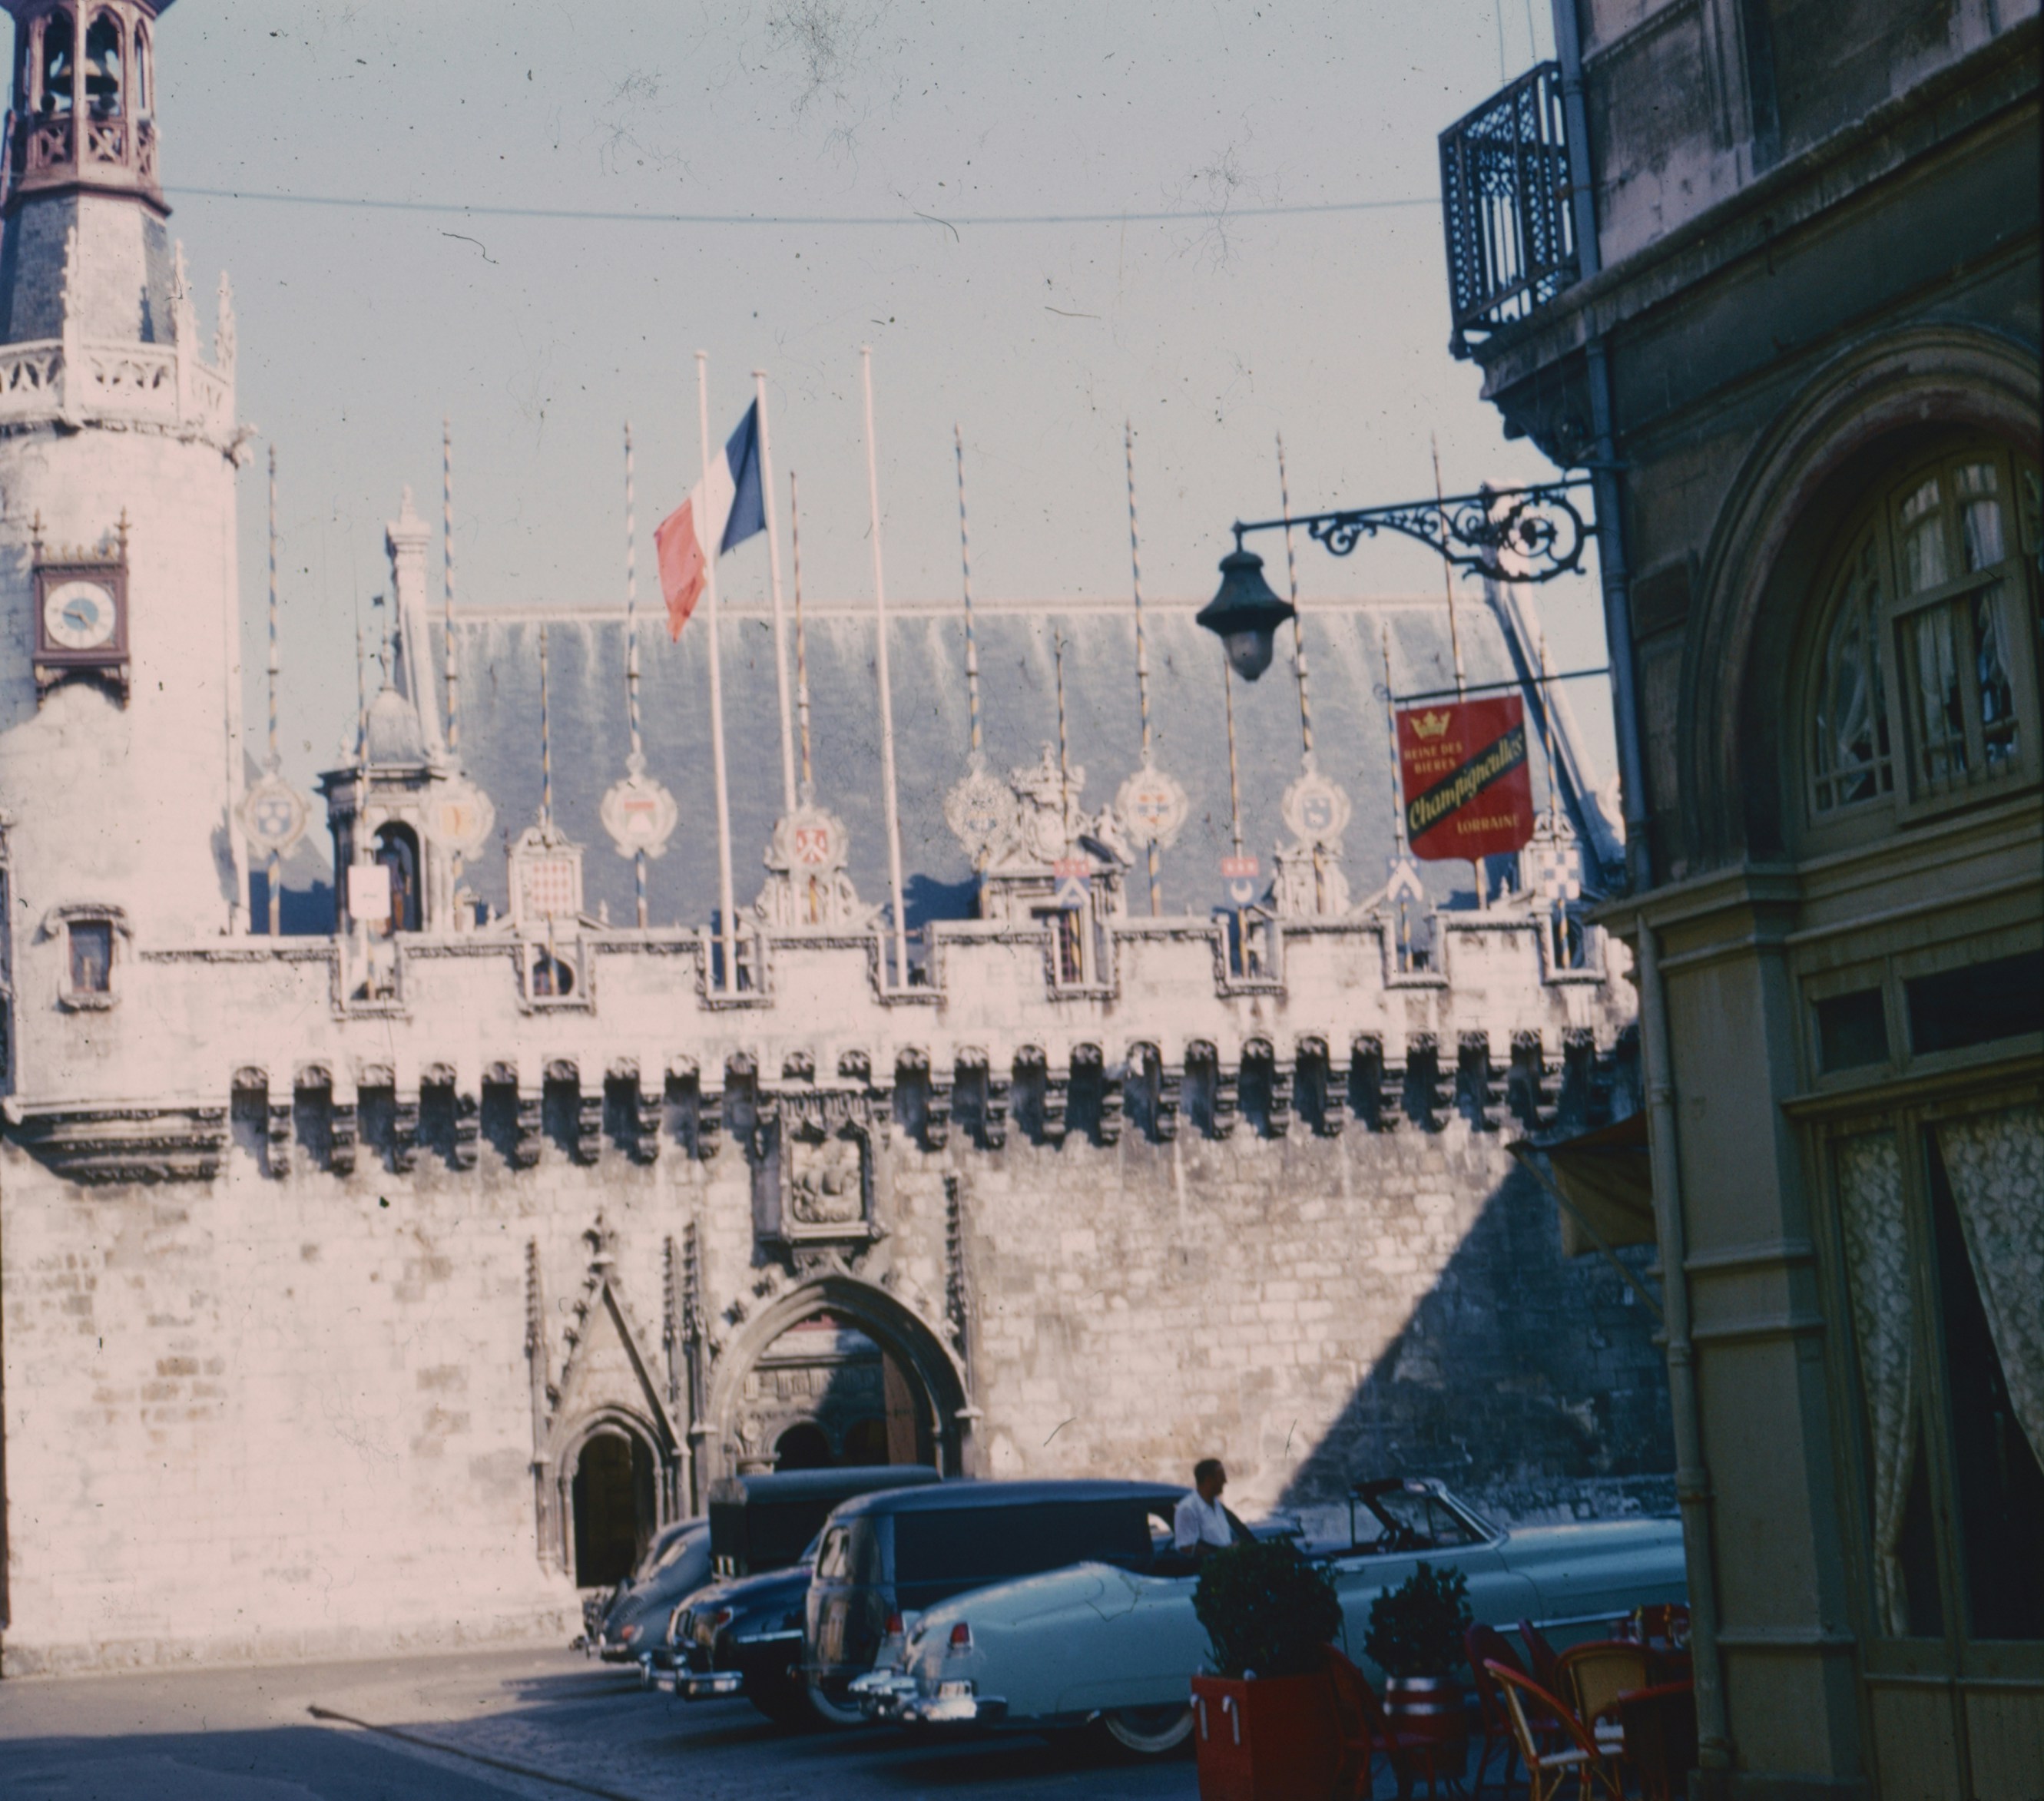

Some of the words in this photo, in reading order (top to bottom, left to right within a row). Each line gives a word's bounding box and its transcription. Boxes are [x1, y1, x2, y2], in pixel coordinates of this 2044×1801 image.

[1404, 746, 1436, 760] REINE
[1440, 741, 1463, 754] DES
[1410, 732, 1522, 830] Champigneulles
[1456, 813, 1519, 834] LORRAINE
